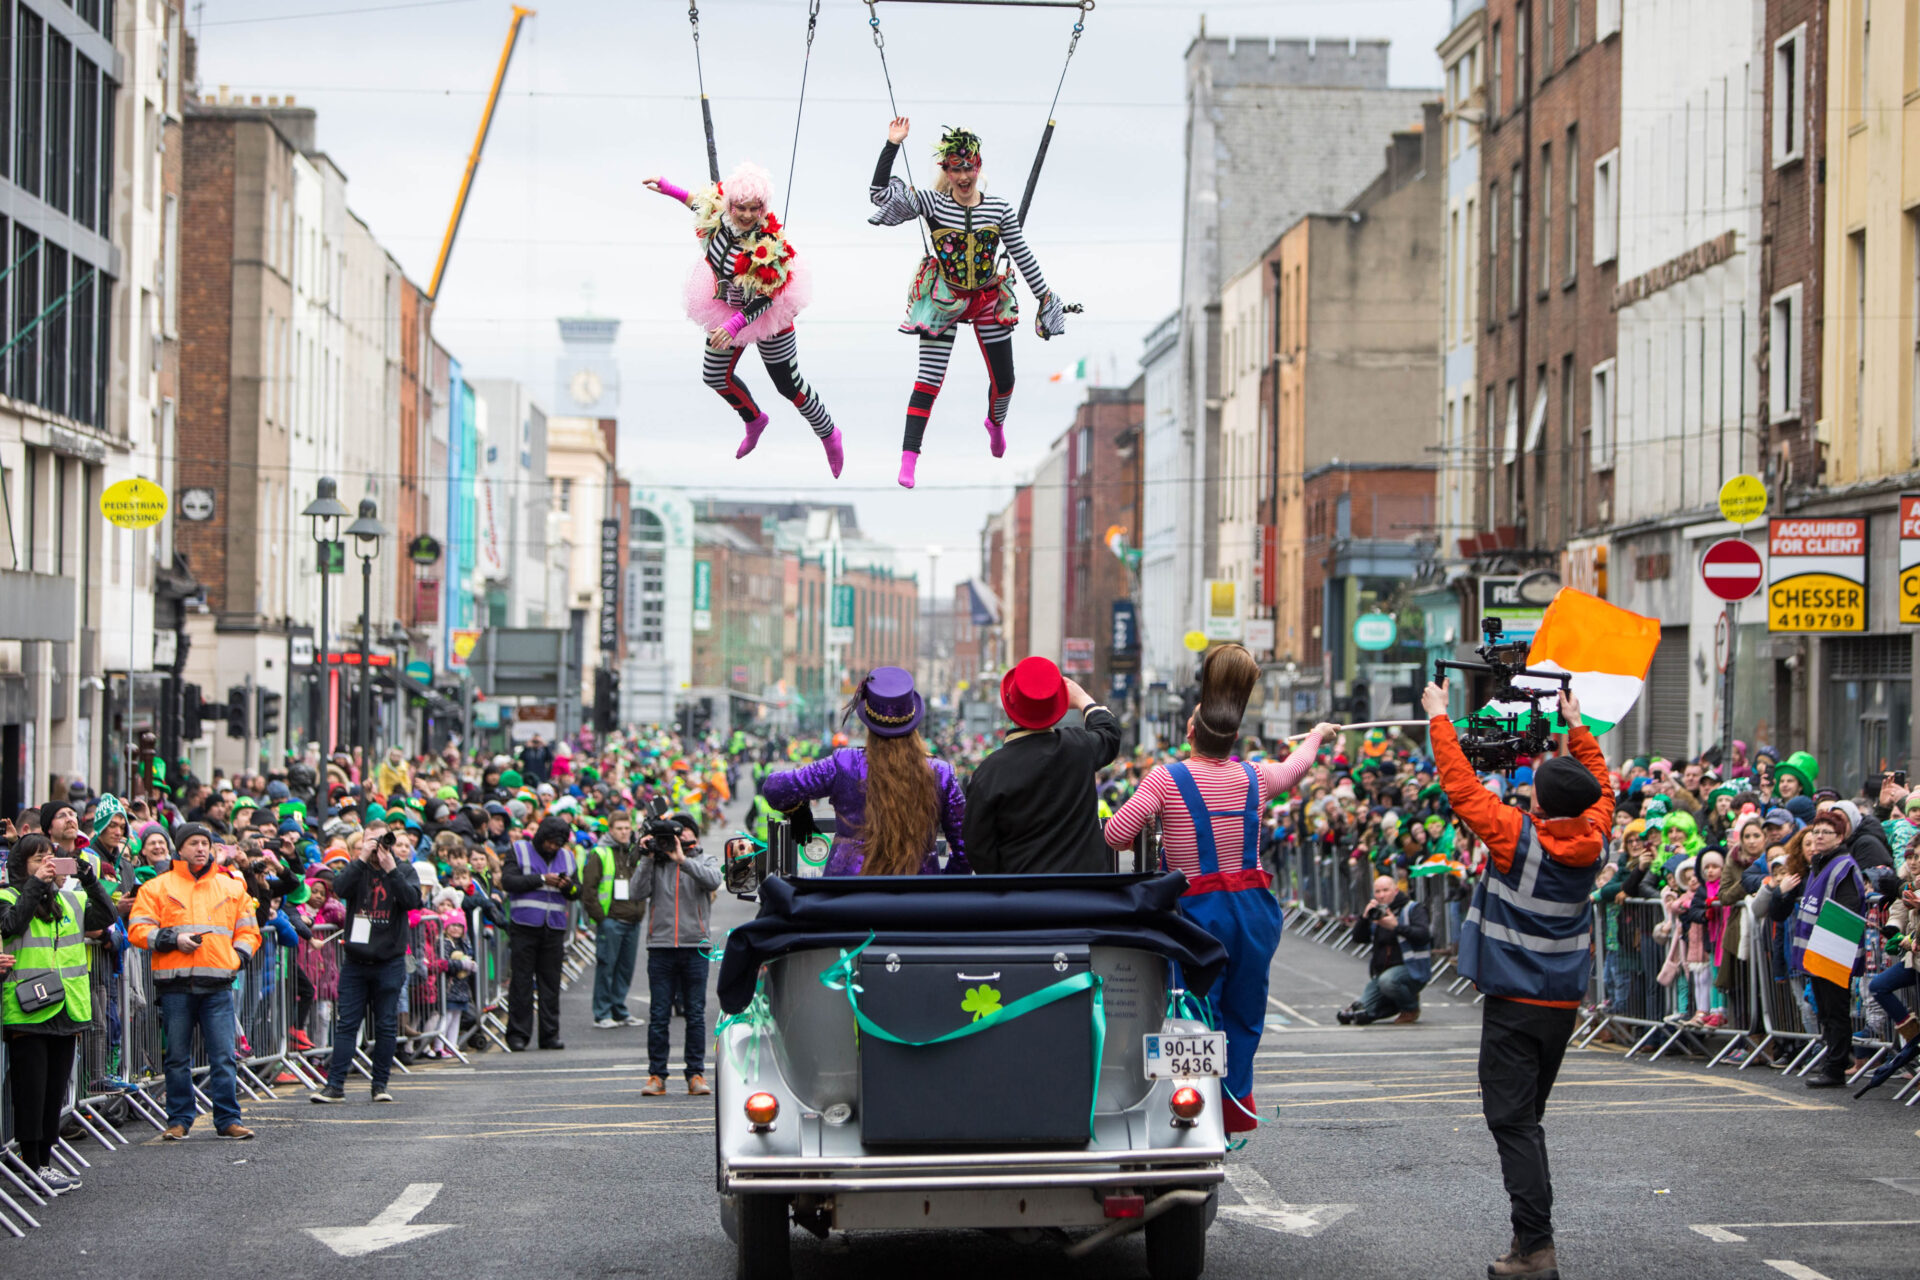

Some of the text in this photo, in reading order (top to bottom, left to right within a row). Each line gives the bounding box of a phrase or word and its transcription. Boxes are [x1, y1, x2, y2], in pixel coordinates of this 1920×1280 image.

[104, 501, 164, 510] PEDESTRIAN
[1721, 495, 1764, 506] PEDESTRIAN
[109, 514, 159, 522] CROSSING
[1725, 507, 1760, 519] CROSSING
[1777, 522, 1858, 538] ACQUIRED
[1771, 538, 1863, 554] FOR CLIENT
[1493, 586, 1520, 603] RE
[1771, 589, 1860, 609] CHESSER
[1777, 613, 1855, 628] 419799
[1164, 1040, 1216, 1057] 90-LK
[1171, 1057, 1212, 1073] 5436
